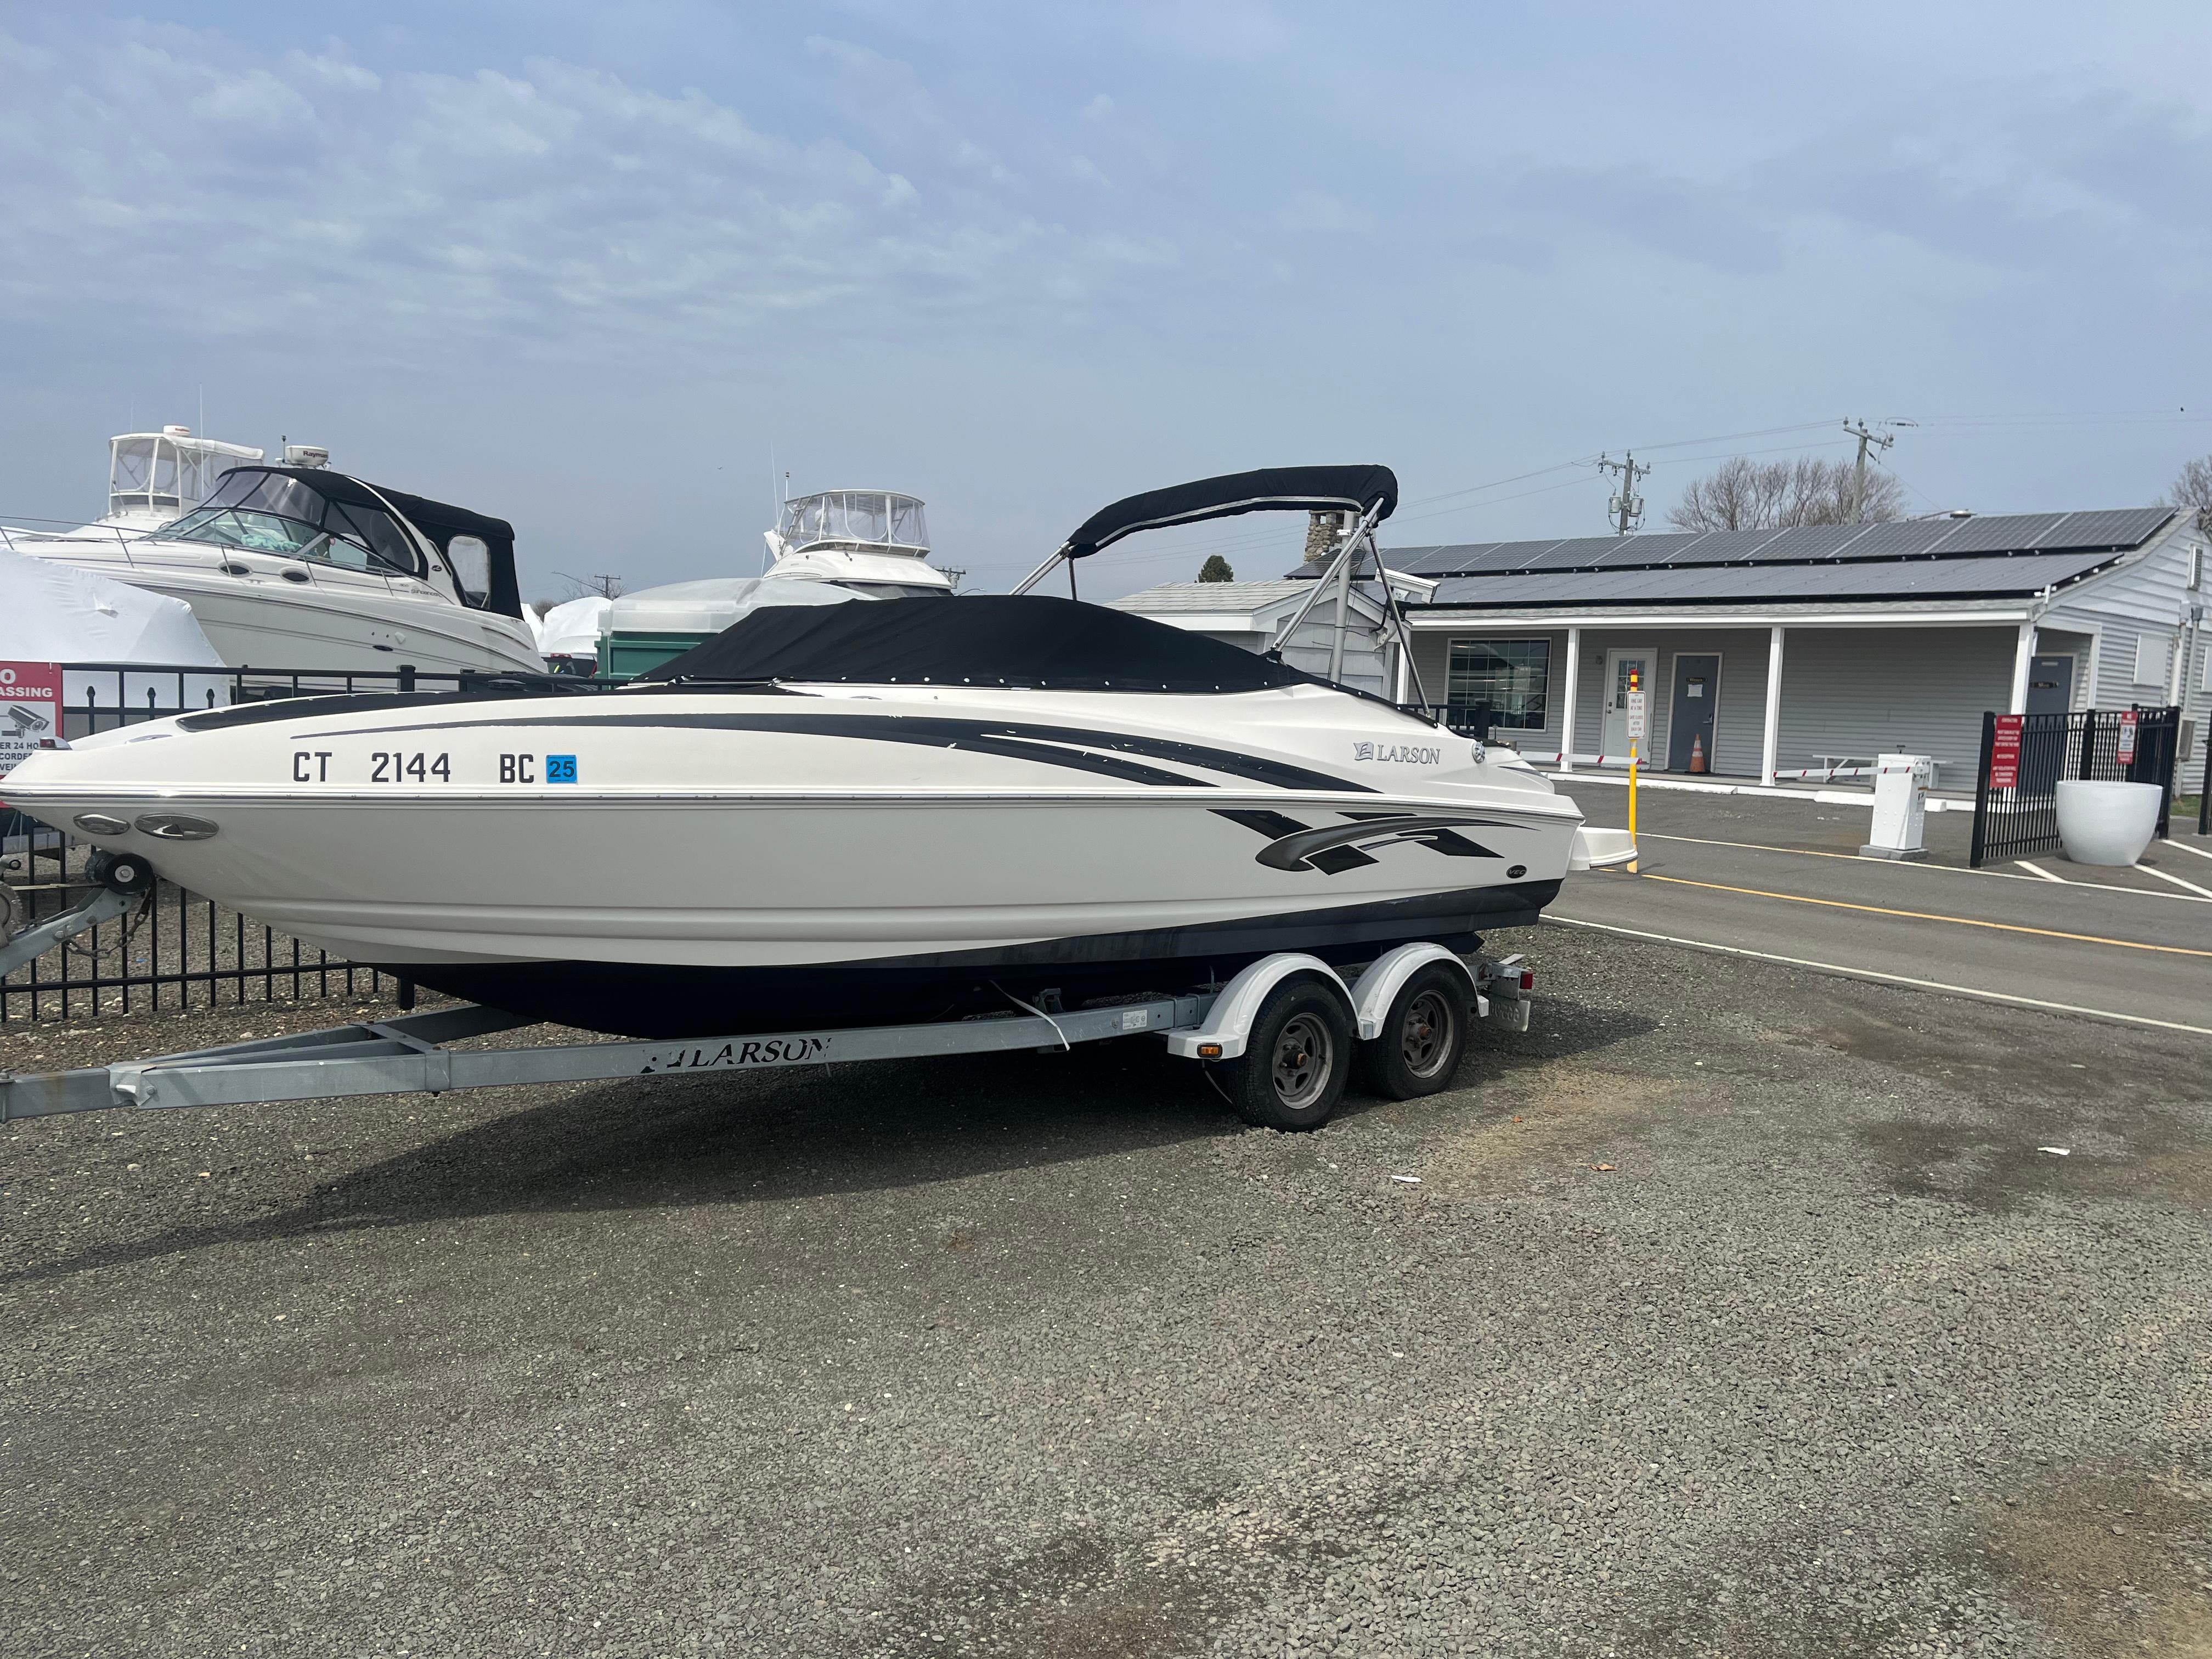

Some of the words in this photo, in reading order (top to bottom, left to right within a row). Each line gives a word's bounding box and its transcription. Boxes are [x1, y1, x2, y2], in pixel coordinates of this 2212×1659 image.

[1377, 744, 1441, 764] LARSON
[294, 752, 332, 782] CT
[371, 752, 451, 783] 2144
[500, 754, 534, 783] BC
[549, 760, 575, 777] 25
